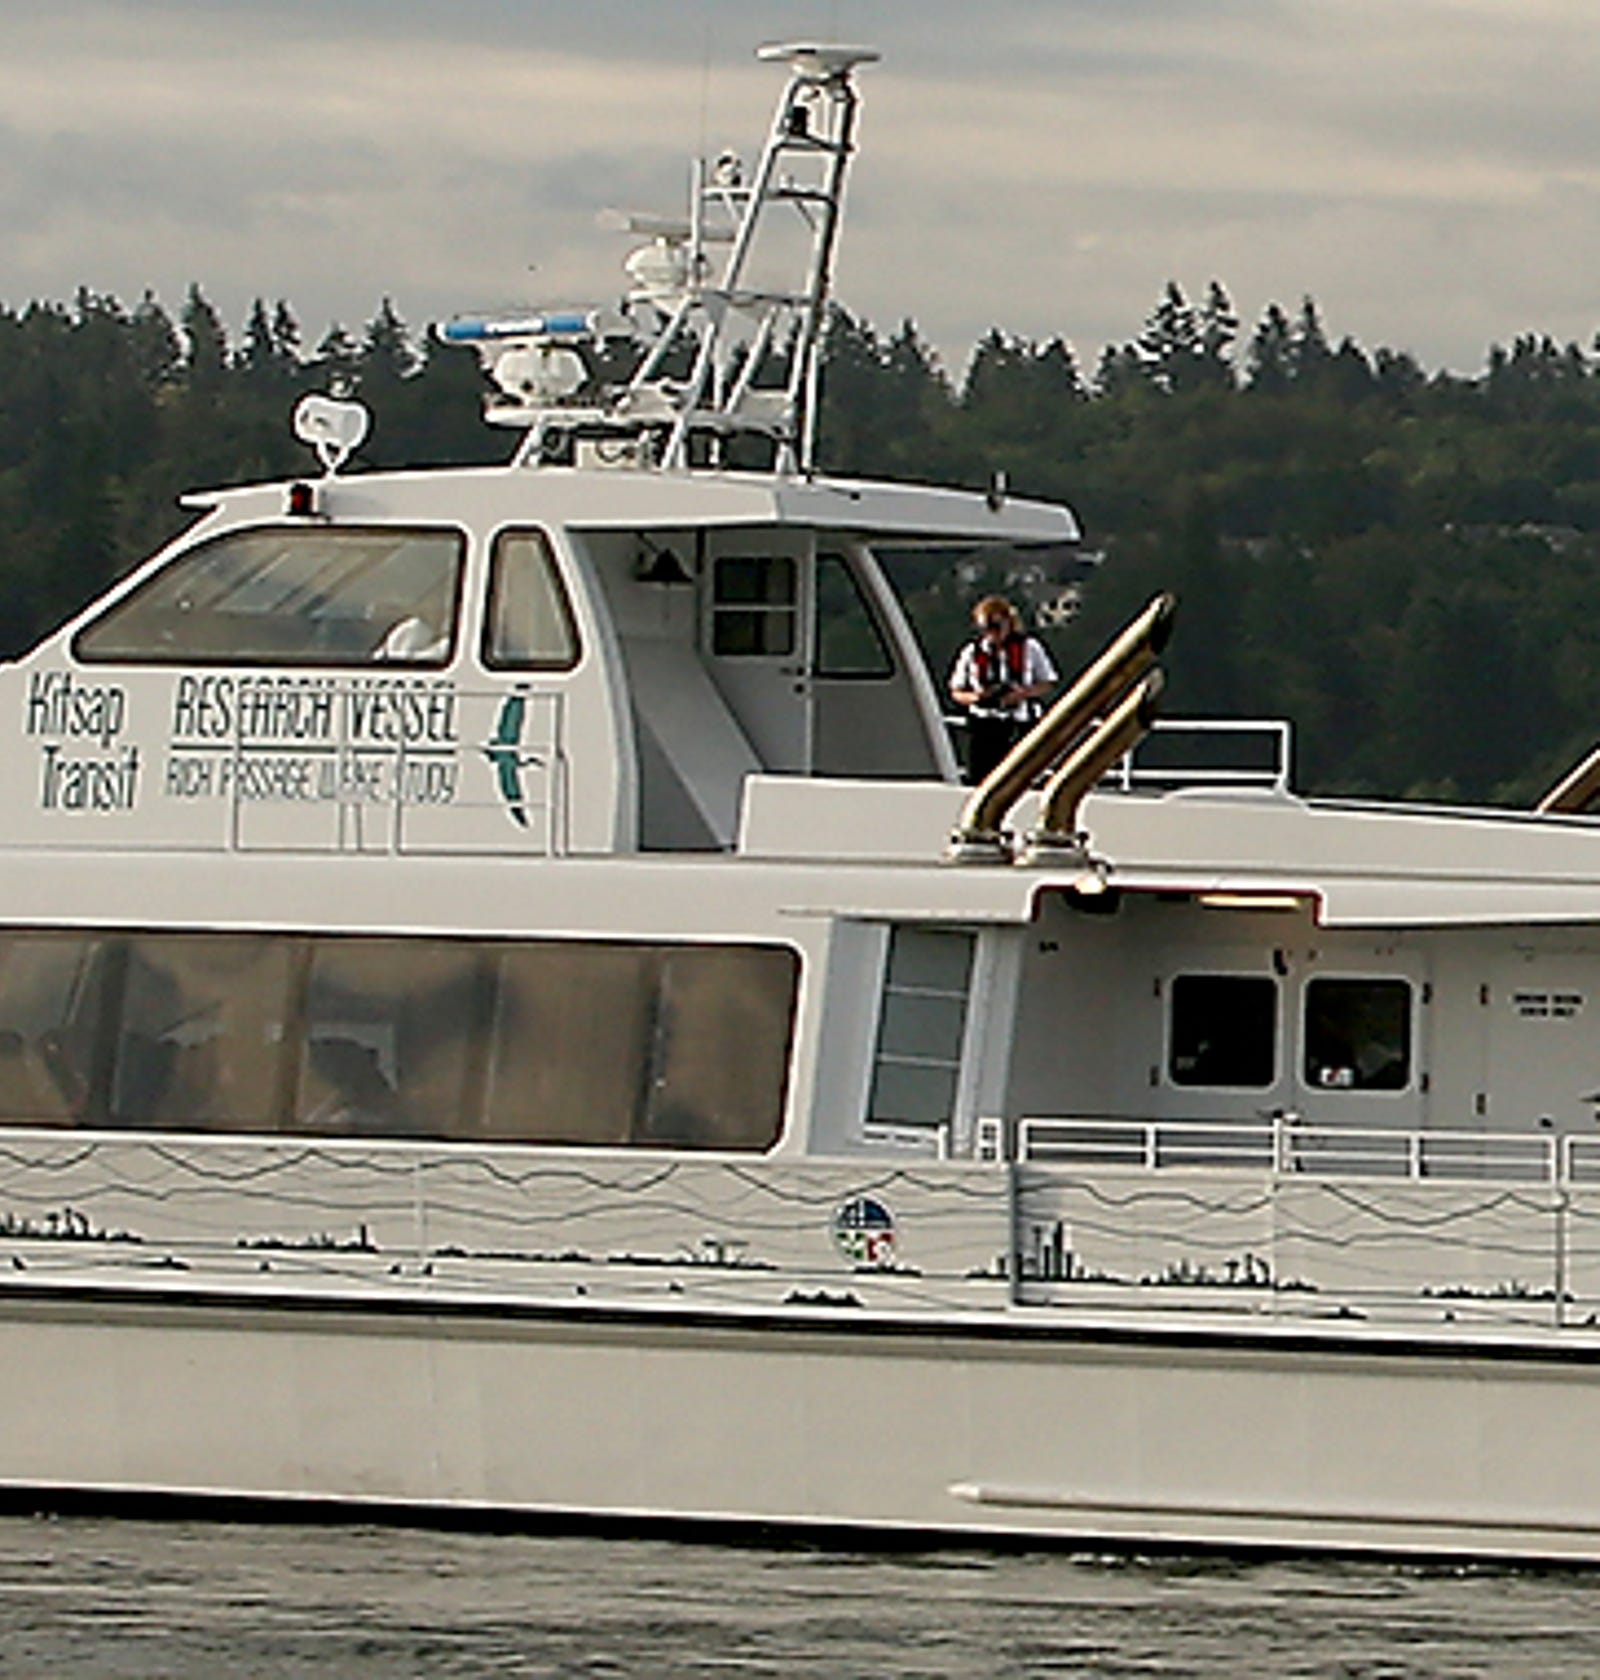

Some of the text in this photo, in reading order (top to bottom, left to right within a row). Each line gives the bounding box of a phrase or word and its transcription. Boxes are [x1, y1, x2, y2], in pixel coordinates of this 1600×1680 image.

[26, 672, 124, 749] Kitsap
[174, 676, 456, 740] RESEARCH VESSEL
[43, 745, 138, 809] Transit
[168, 758, 212, 795] RICH
[220, 758, 312, 800] PASSAGE
